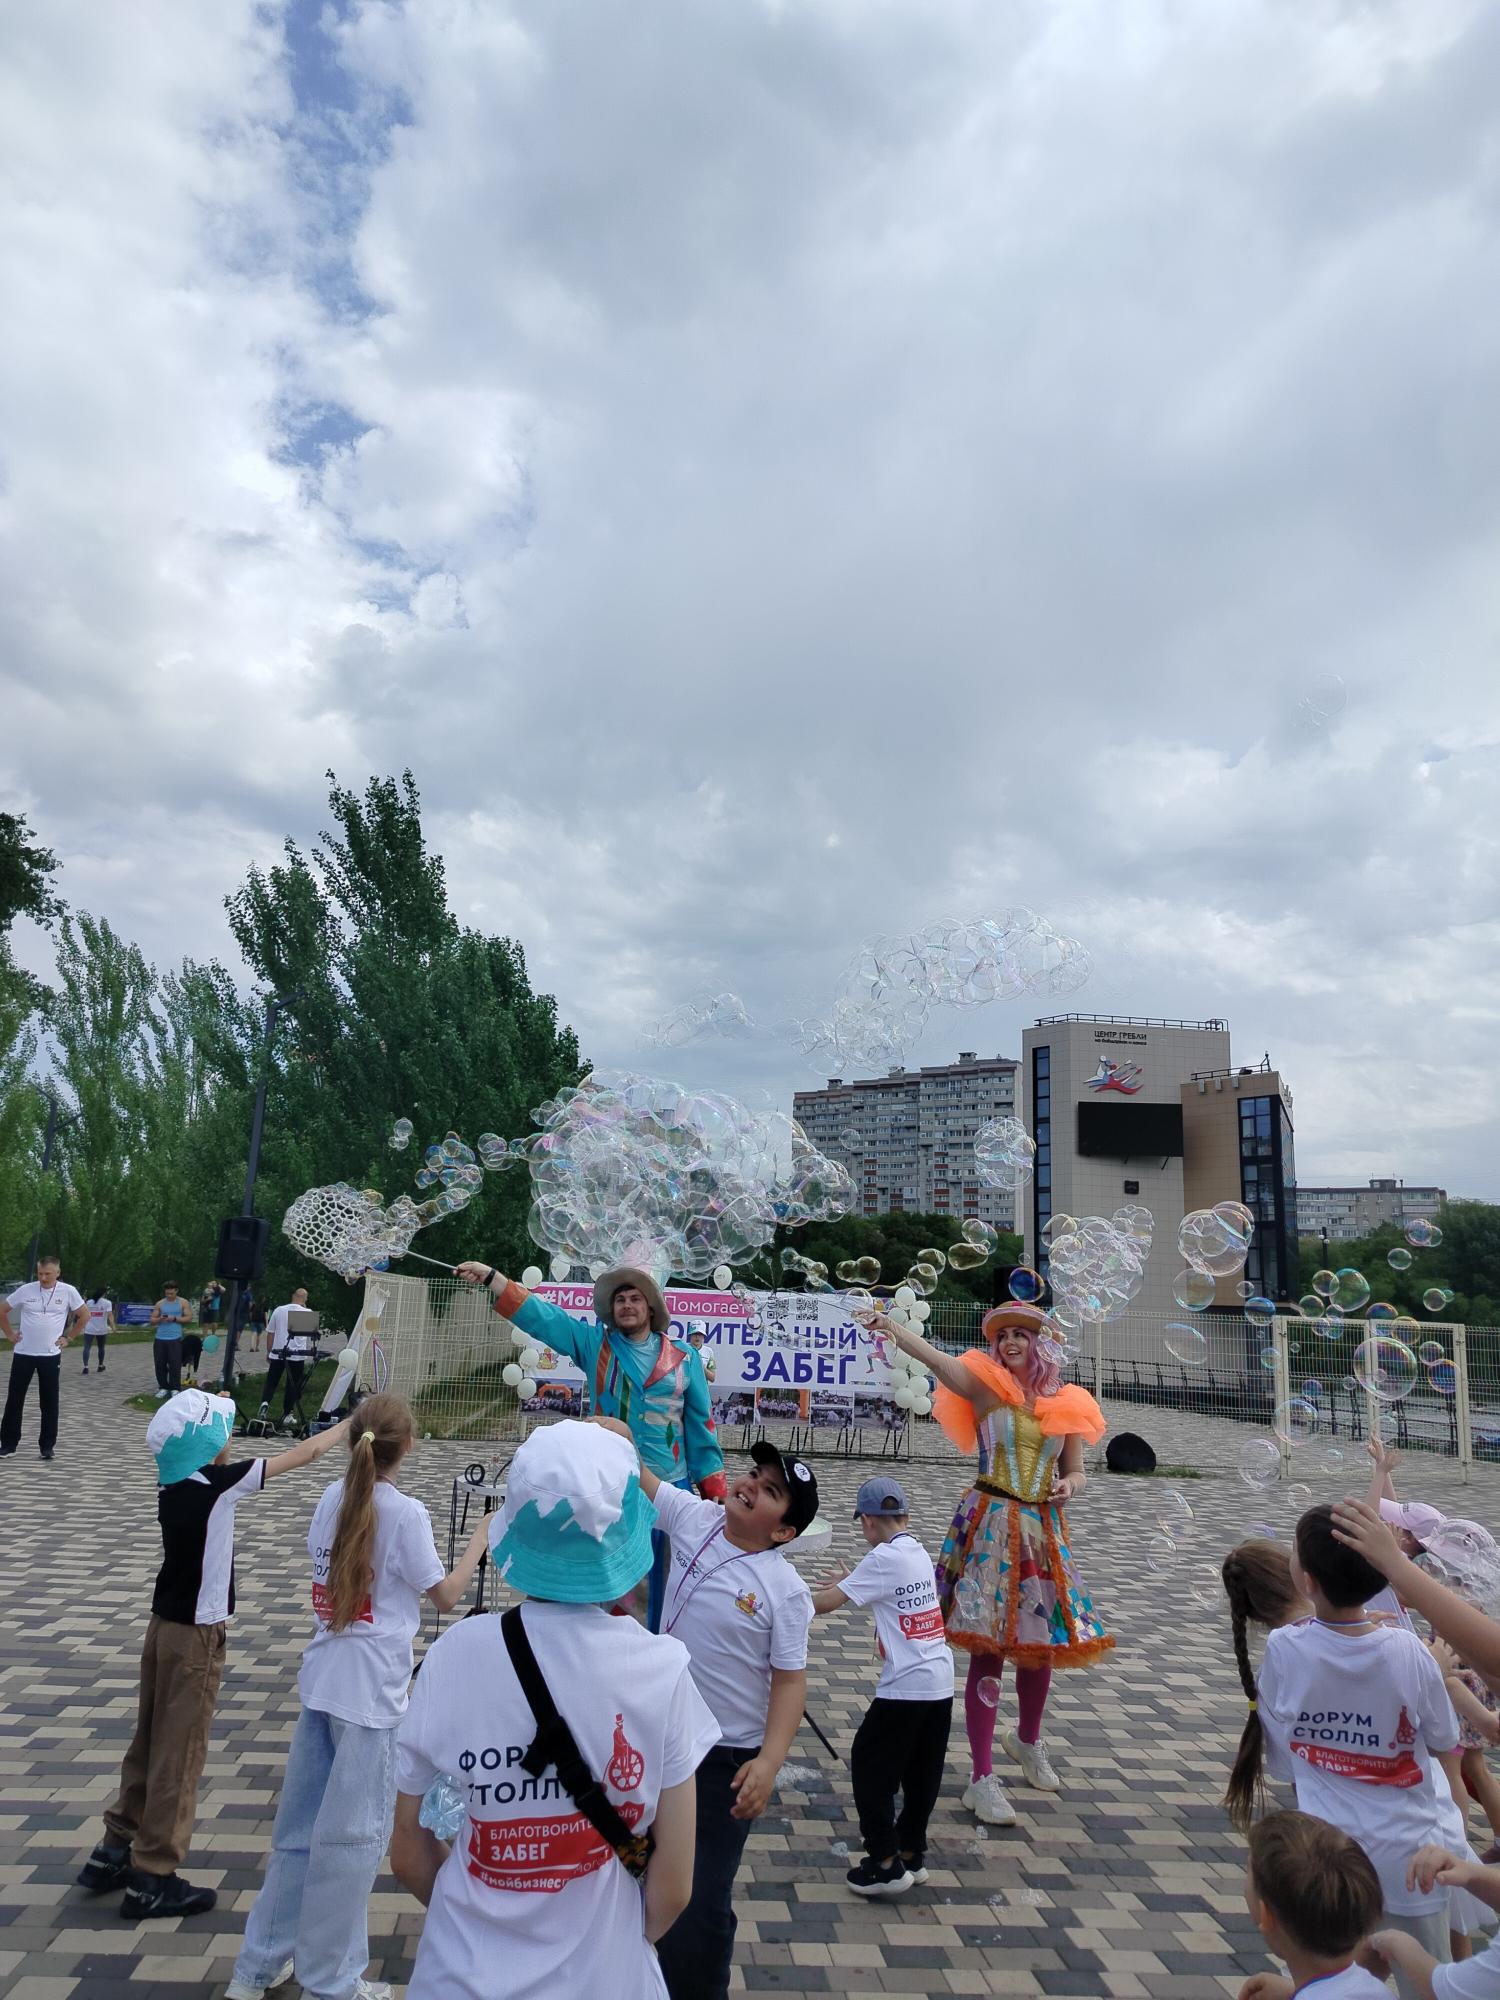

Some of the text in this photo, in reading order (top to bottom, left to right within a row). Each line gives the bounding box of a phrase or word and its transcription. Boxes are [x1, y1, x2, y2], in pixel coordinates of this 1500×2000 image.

[1094, 1030, 1147, 1040] ЦЕНТР ГРЕБЛИ
[741, 1351, 857, 1385] ЗАБЕГ
[895, 1579, 932, 1596] ФОРУМ
[897, 1592, 936, 1609] СТОЛЛЯ
[915, 1620, 935, 1631] ЗАБЕГ
[1297, 1711, 1372, 1728] ФОРУМ
[1293, 1727, 1380, 1747] СТОЛЛЯ
[458, 1745, 524, 1773] ФОР
[468, 1778, 573, 1806] ТОЛЛ
[491, 1842, 550, 1862] ЗАБЕГ
